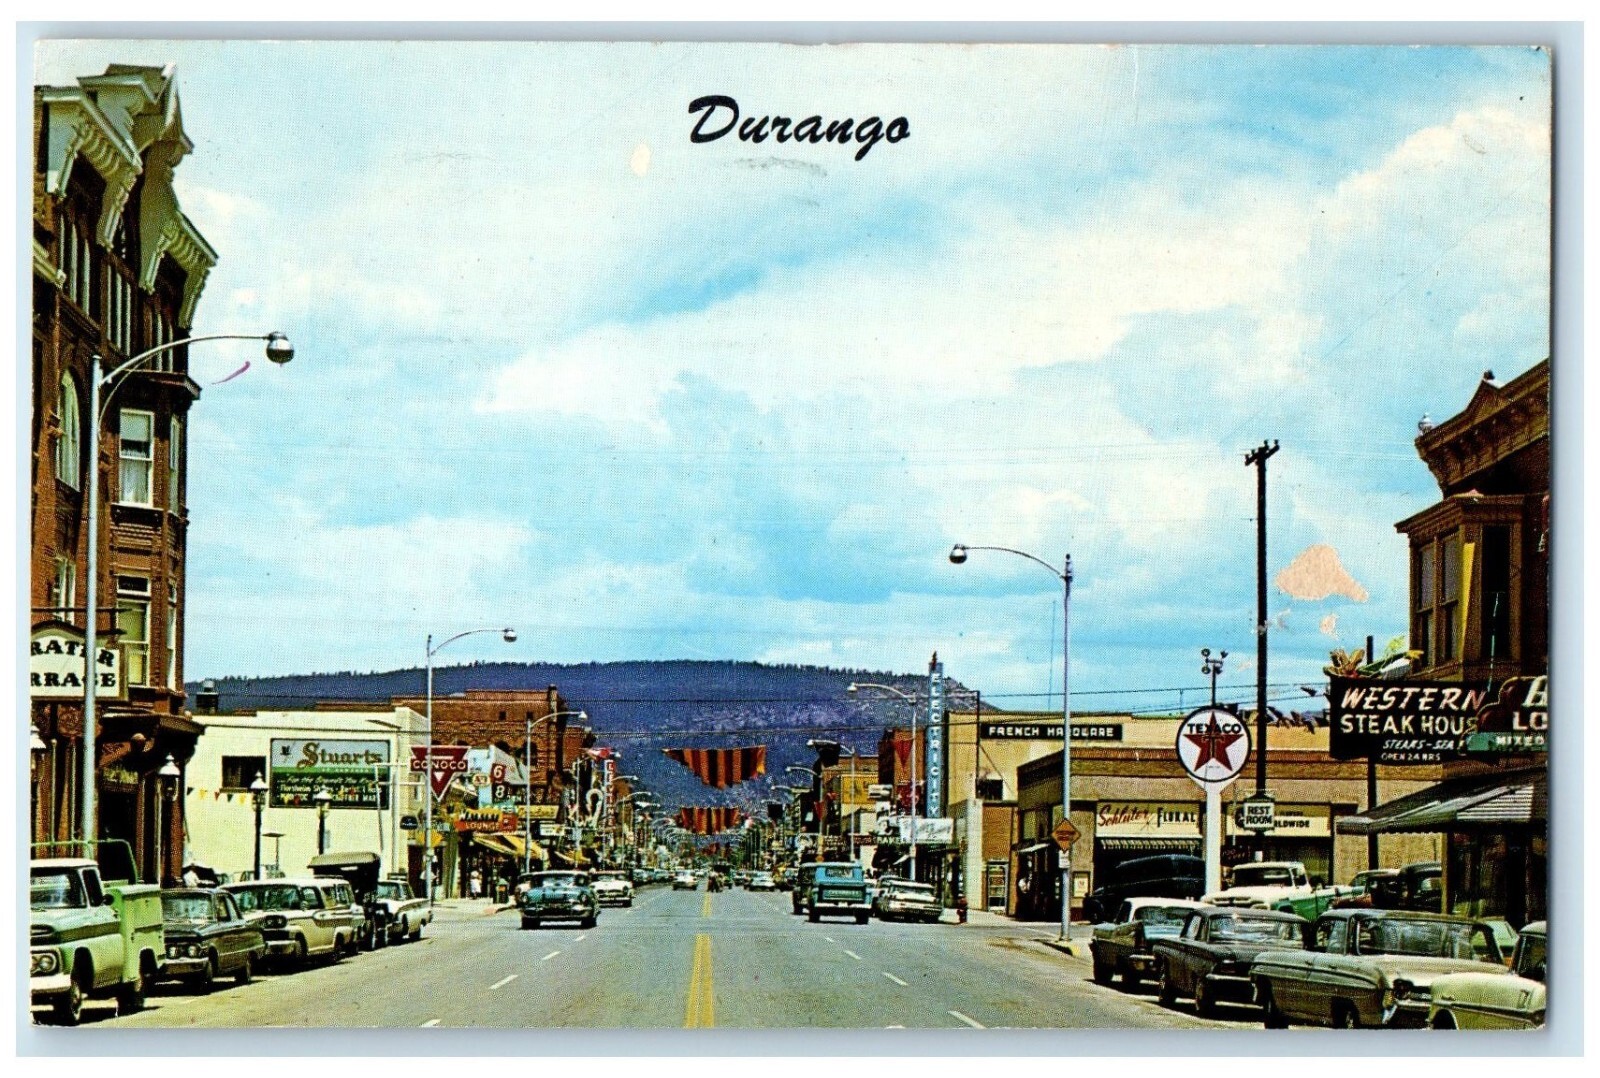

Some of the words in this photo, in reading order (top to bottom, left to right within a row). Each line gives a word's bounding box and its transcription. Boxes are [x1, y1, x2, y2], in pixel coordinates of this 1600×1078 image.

[31, 639, 115, 667] RATR
[1341, 686, 1487, 711] WESTERN
[988, 726, 1040, 736] FRENCH
[1047, 727, 1114, 736] HADWARE
[1187, 722, 1242, 734] TEXACO
[1340, 714, 1415, 734] STEAK
[928, 673, 941, 816] ELECTRICITY
[413, 759, 467, 770] CONOCO
[1157, 807, 1196, 827] FLORAL
[1248, 806, 1271, 815] REST
[1245, 815, 1273, 825] ROOM
